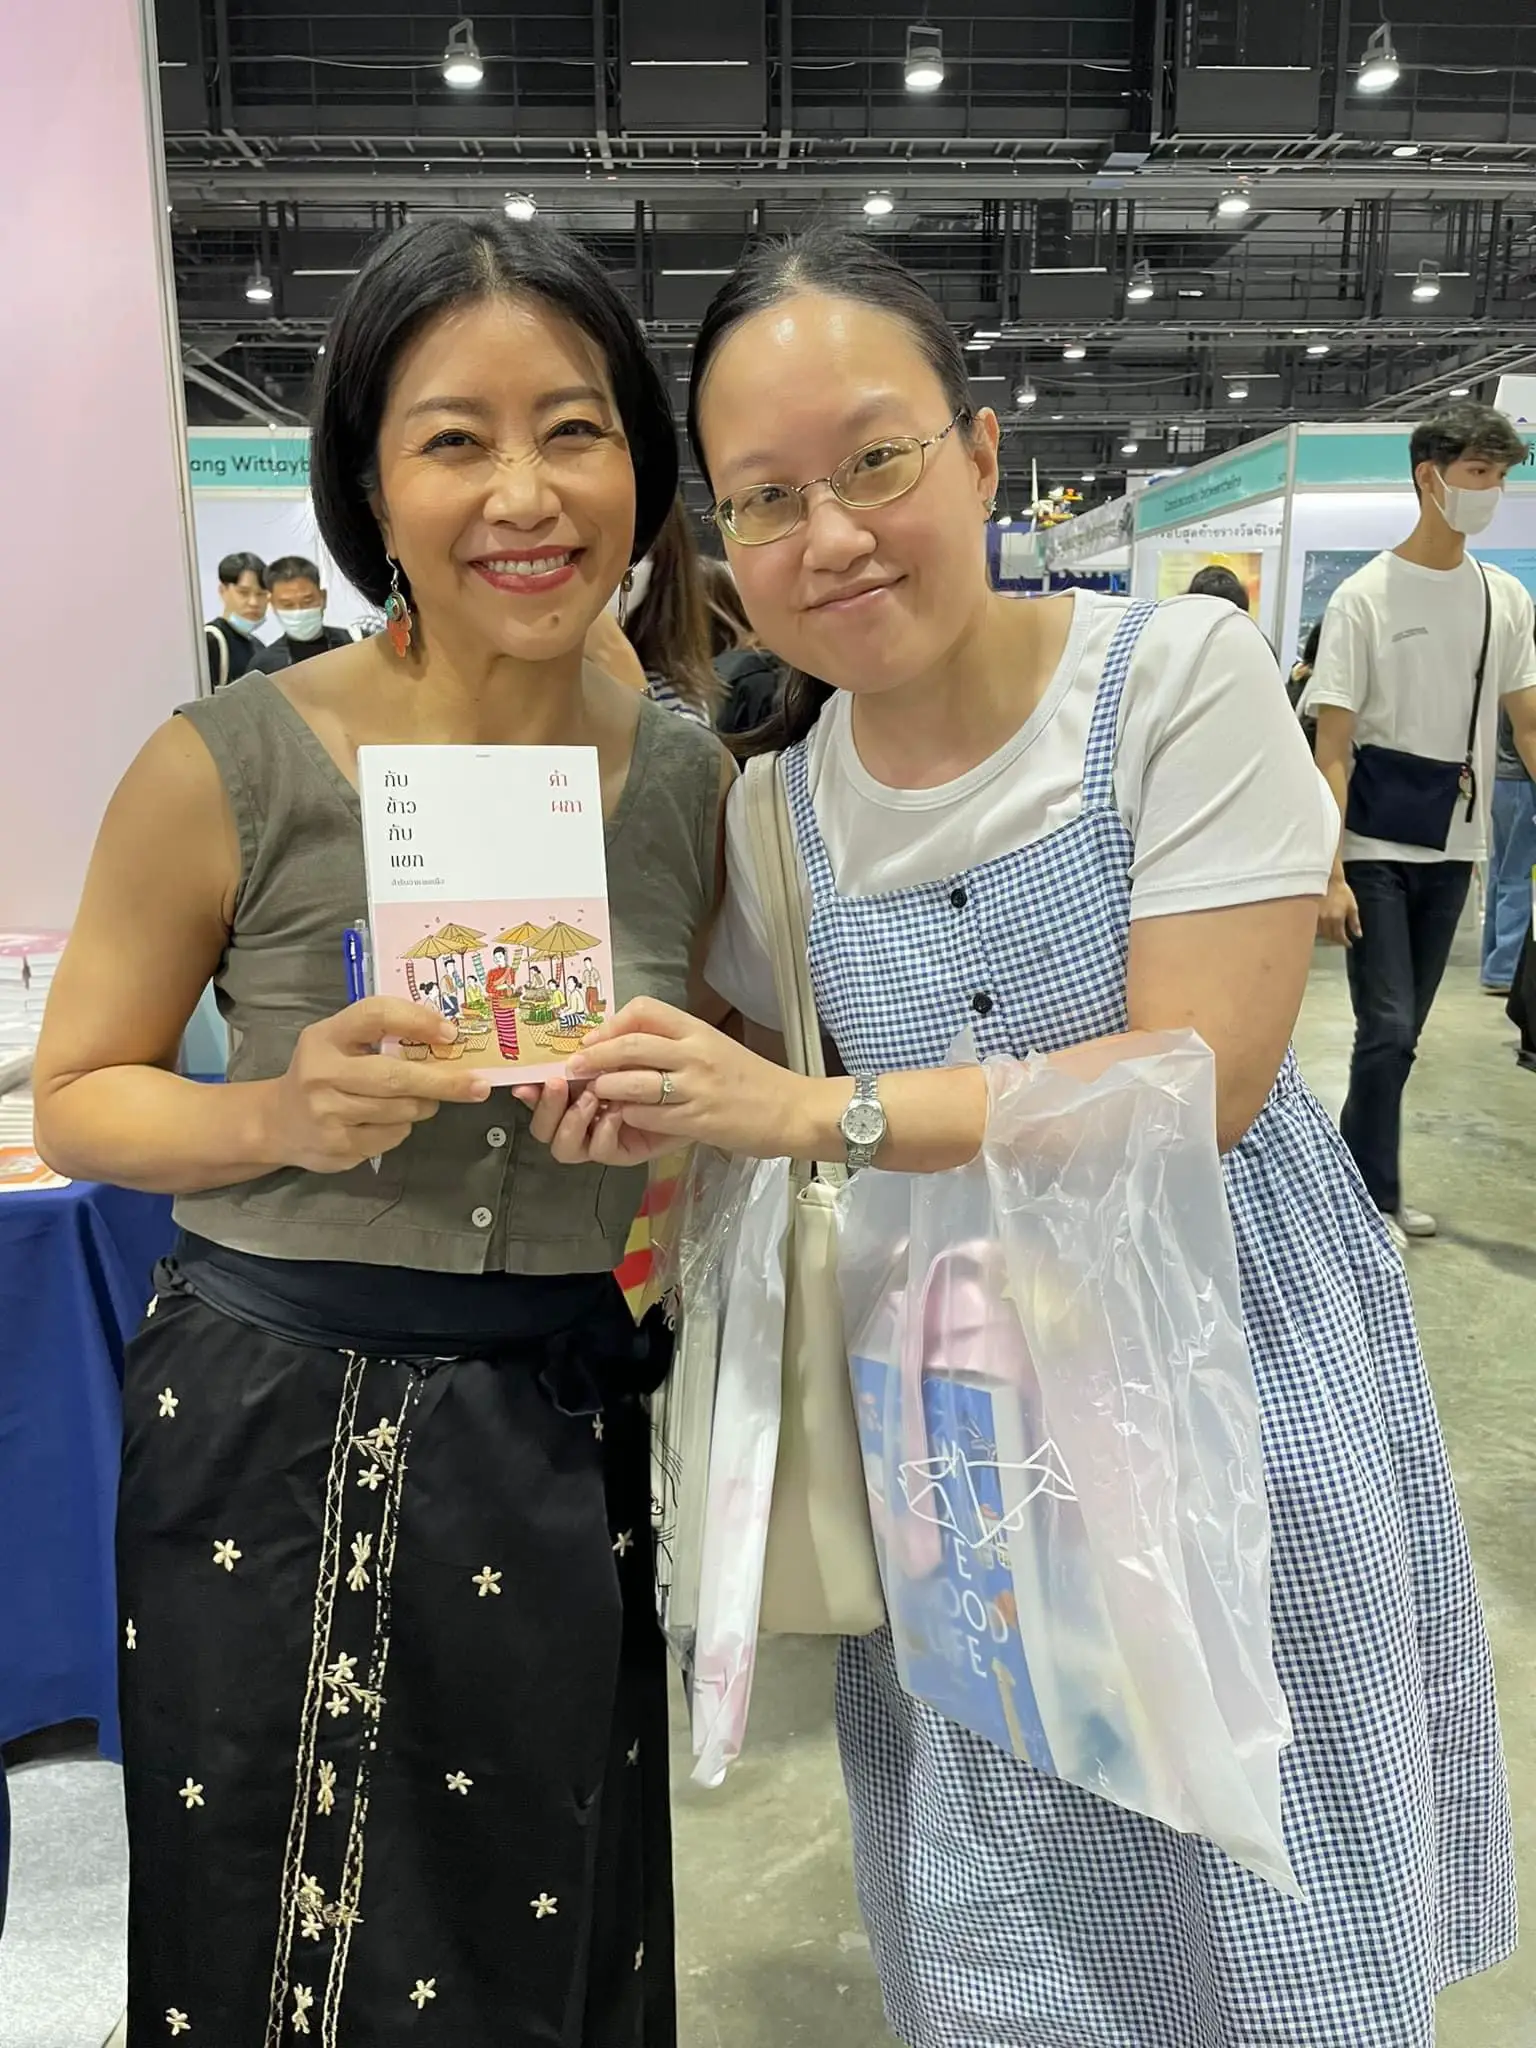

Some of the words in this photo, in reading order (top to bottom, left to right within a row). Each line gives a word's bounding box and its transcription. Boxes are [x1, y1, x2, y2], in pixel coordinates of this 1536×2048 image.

[384, 770, 408, 787] กับ
[549, 769, 567, 786] คำ
[387, 796, 416, 814] ข้าว
[389, 824, 412, 841] กับ
[391, 854, 424, 868] แขก
